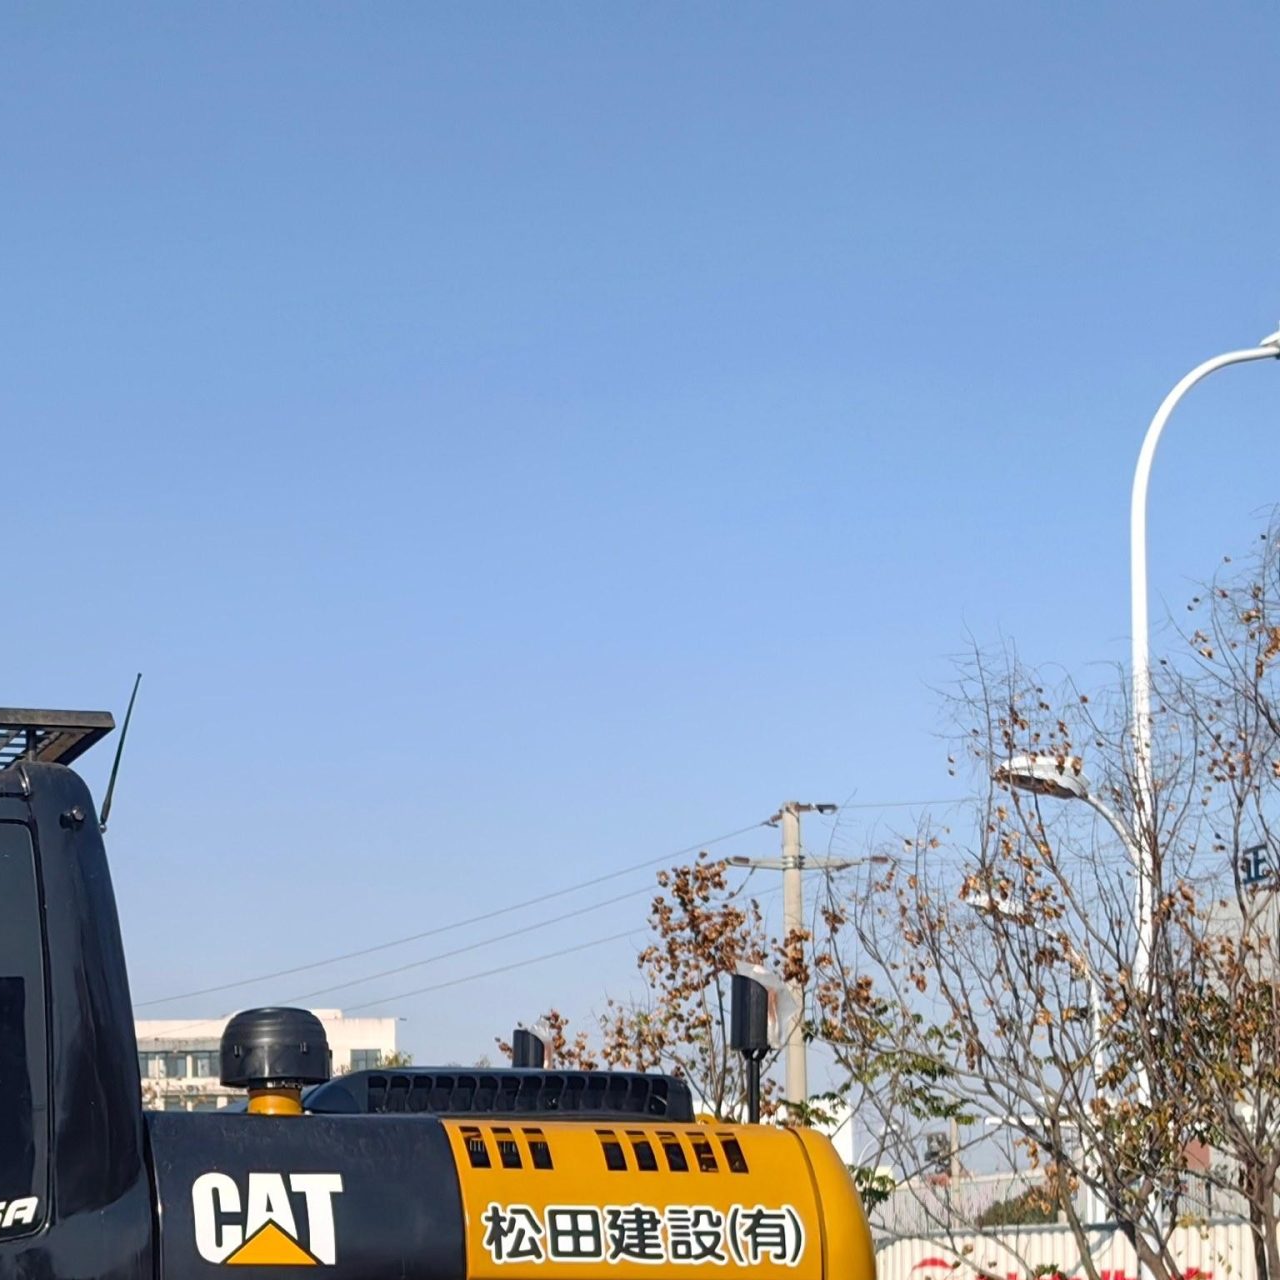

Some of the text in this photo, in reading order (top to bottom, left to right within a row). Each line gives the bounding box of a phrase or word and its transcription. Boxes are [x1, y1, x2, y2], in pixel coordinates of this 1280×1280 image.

[192, 1172, 344, 1265] CAT
[483, 1204, 803, 1264] 松田建設(有)
